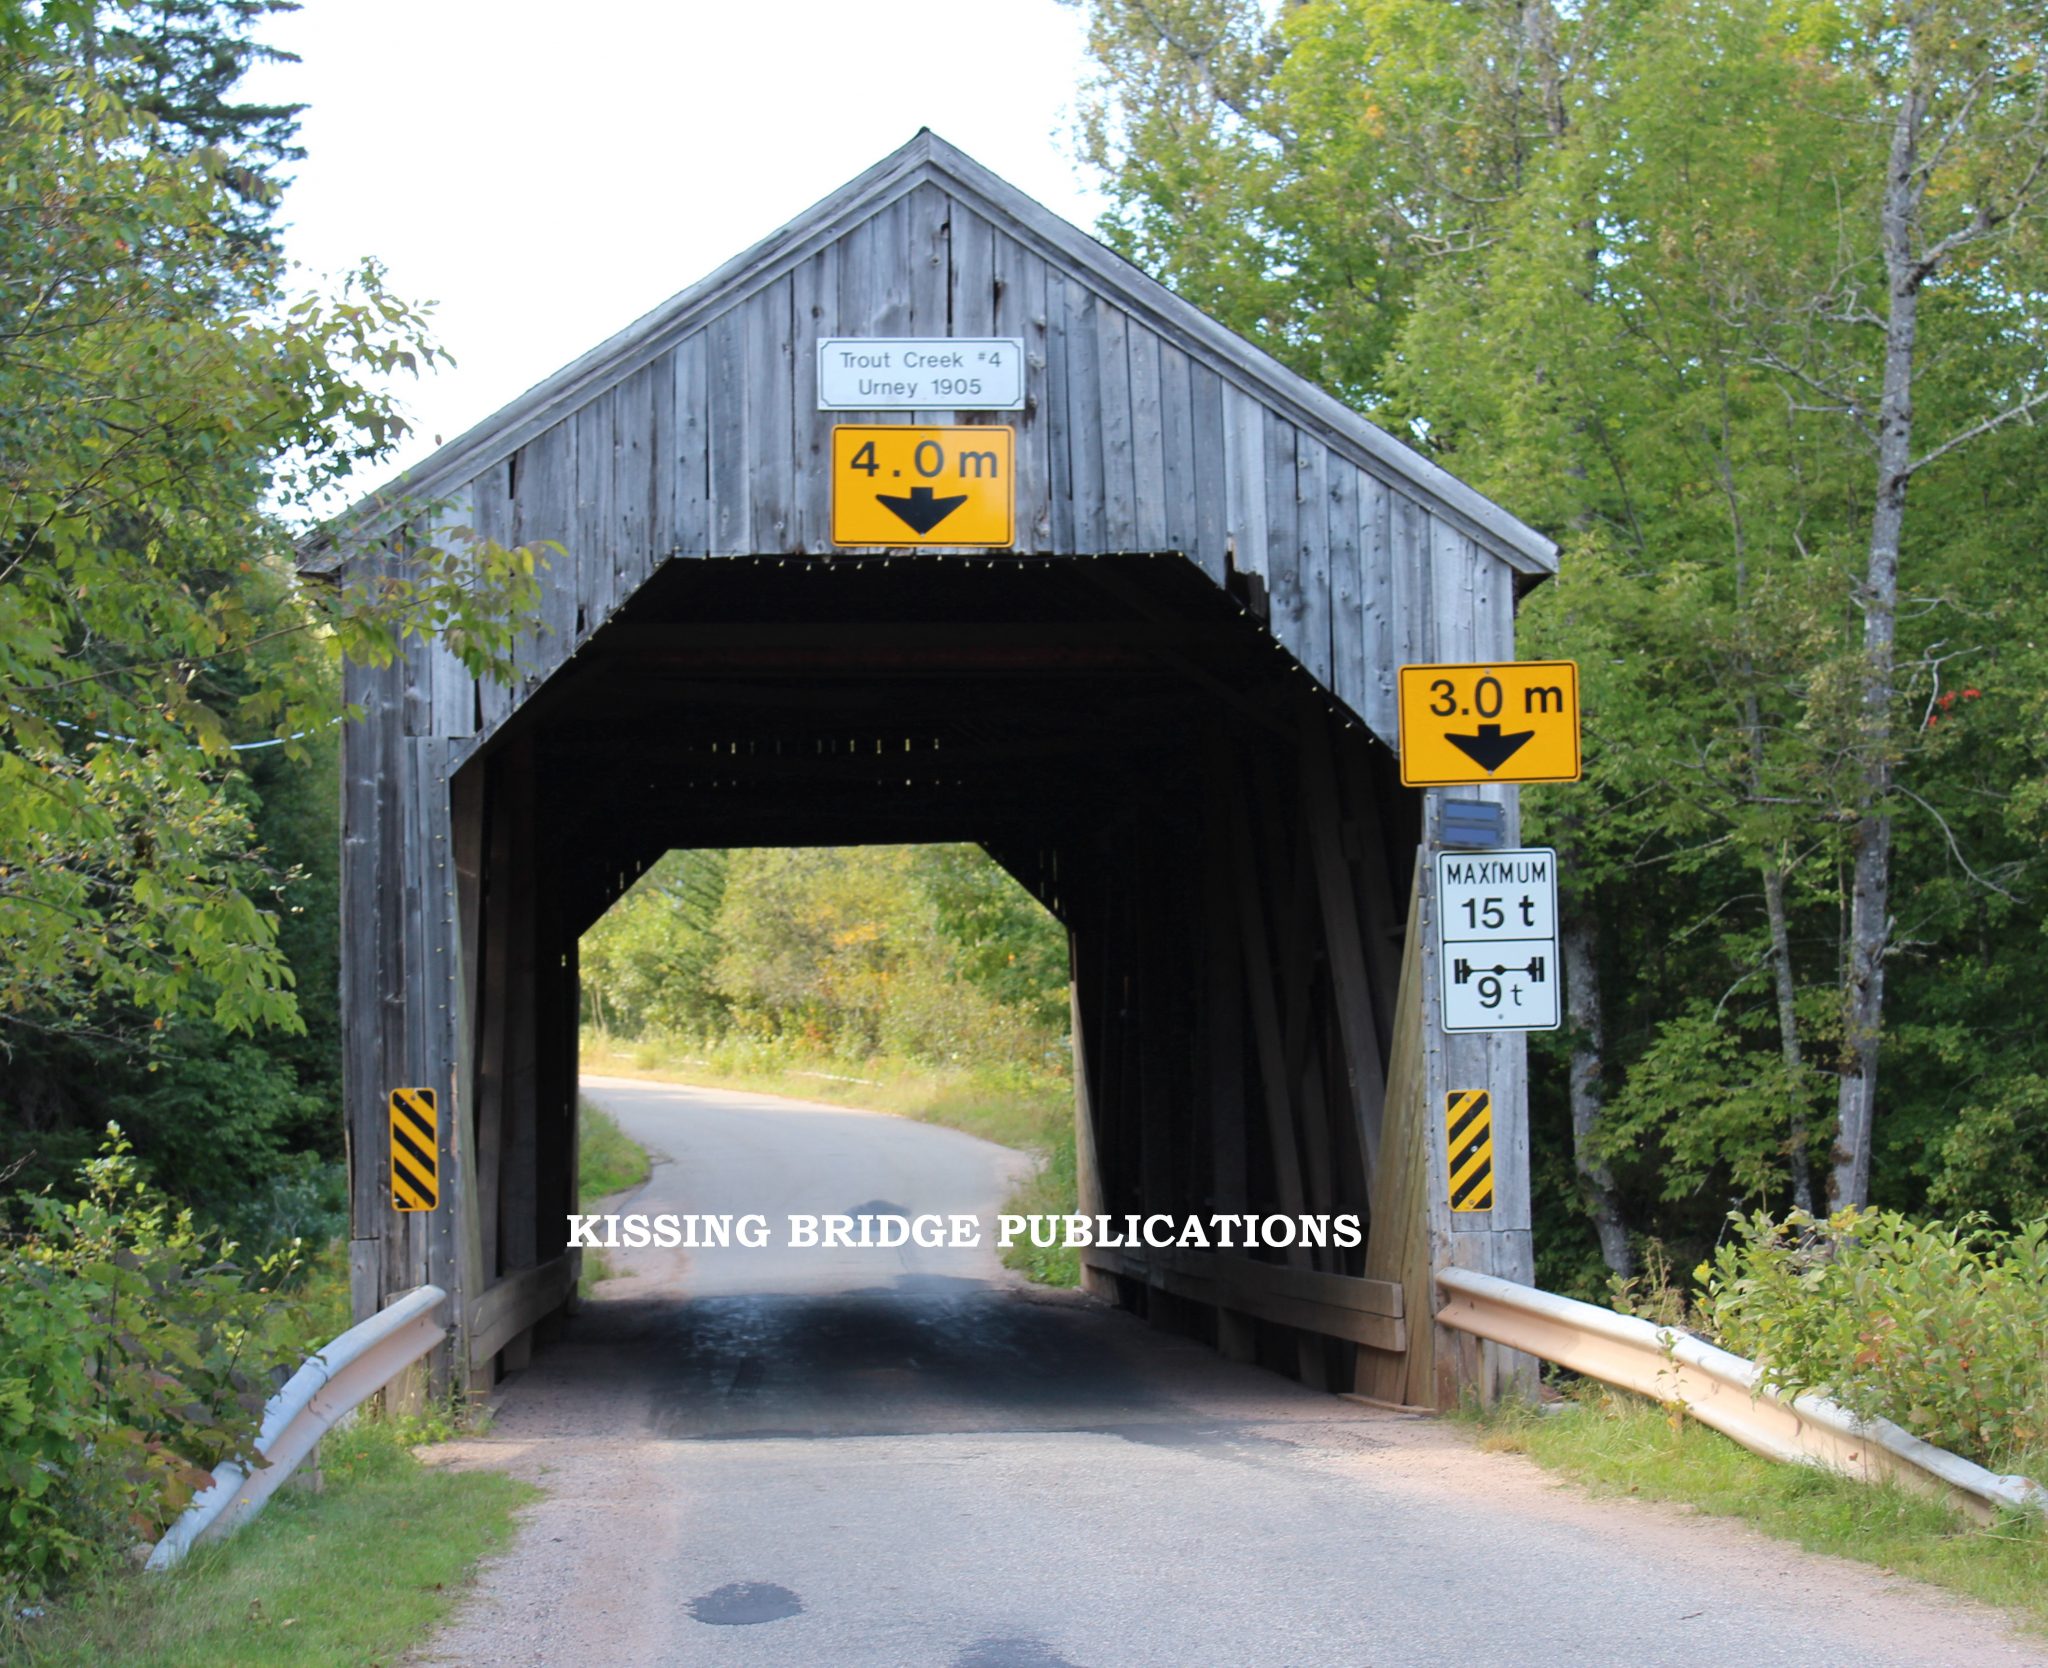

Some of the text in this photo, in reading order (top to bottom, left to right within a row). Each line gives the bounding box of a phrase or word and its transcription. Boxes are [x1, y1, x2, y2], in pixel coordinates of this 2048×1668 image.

[840, 352, 891, 368] Trout
[903, 351, 964, 368] Creek
[858, 378, 982, 398] Urney 1905
[959, 450, 998, 478] m
[1429, 676, 1563, 719] 3.0 m
[1447, 861, 1546, 885] MAXIMUM
[1461, 895, 1534, 929] 15 t
[1477, 976, 1523, 1008] 9 t
